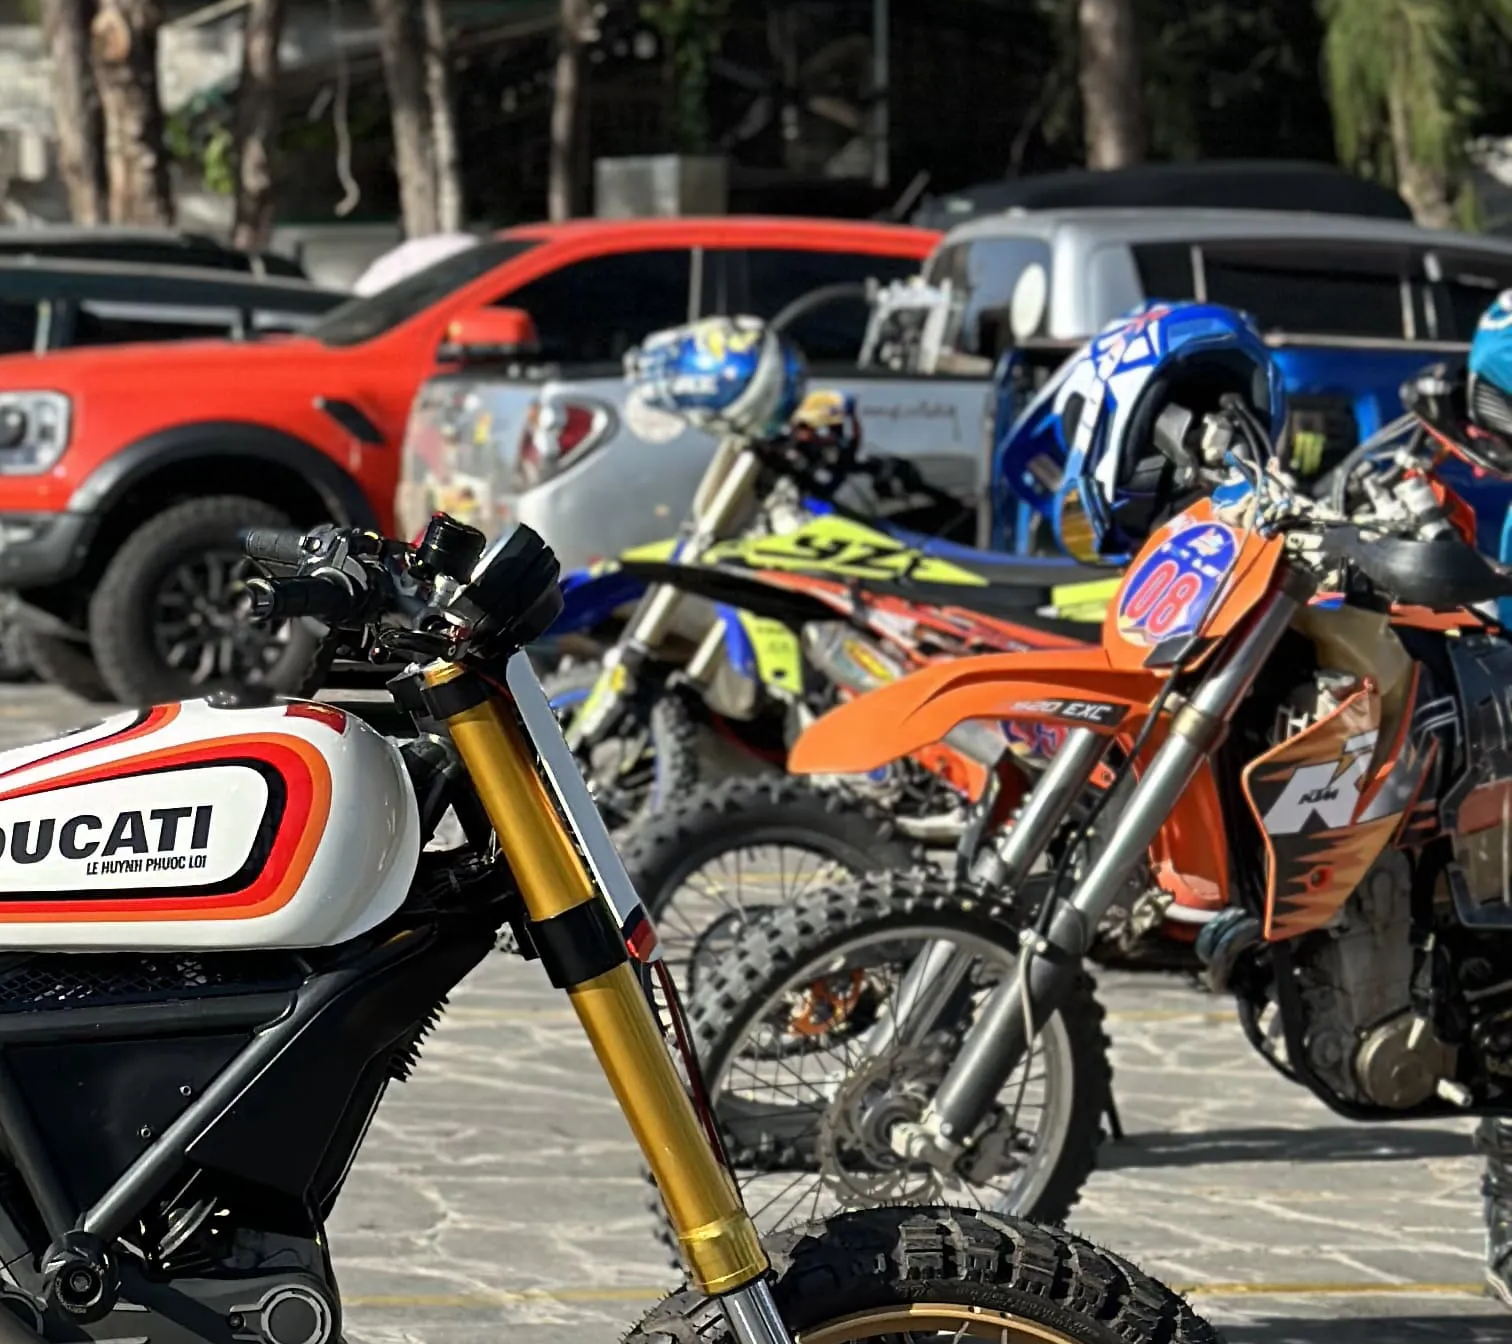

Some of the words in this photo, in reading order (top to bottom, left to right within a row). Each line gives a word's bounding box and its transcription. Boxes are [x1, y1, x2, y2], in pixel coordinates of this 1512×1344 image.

[1124, 559, 1203, 637] 08
[1061, 702, 1112, 721] EXC
[1298, 787, 1339, 806] KTM
[86, 862, 99, 875] LE
[101, 859, 143, 874] HUYNH
[146, 856, 186, 872] PHUOC
